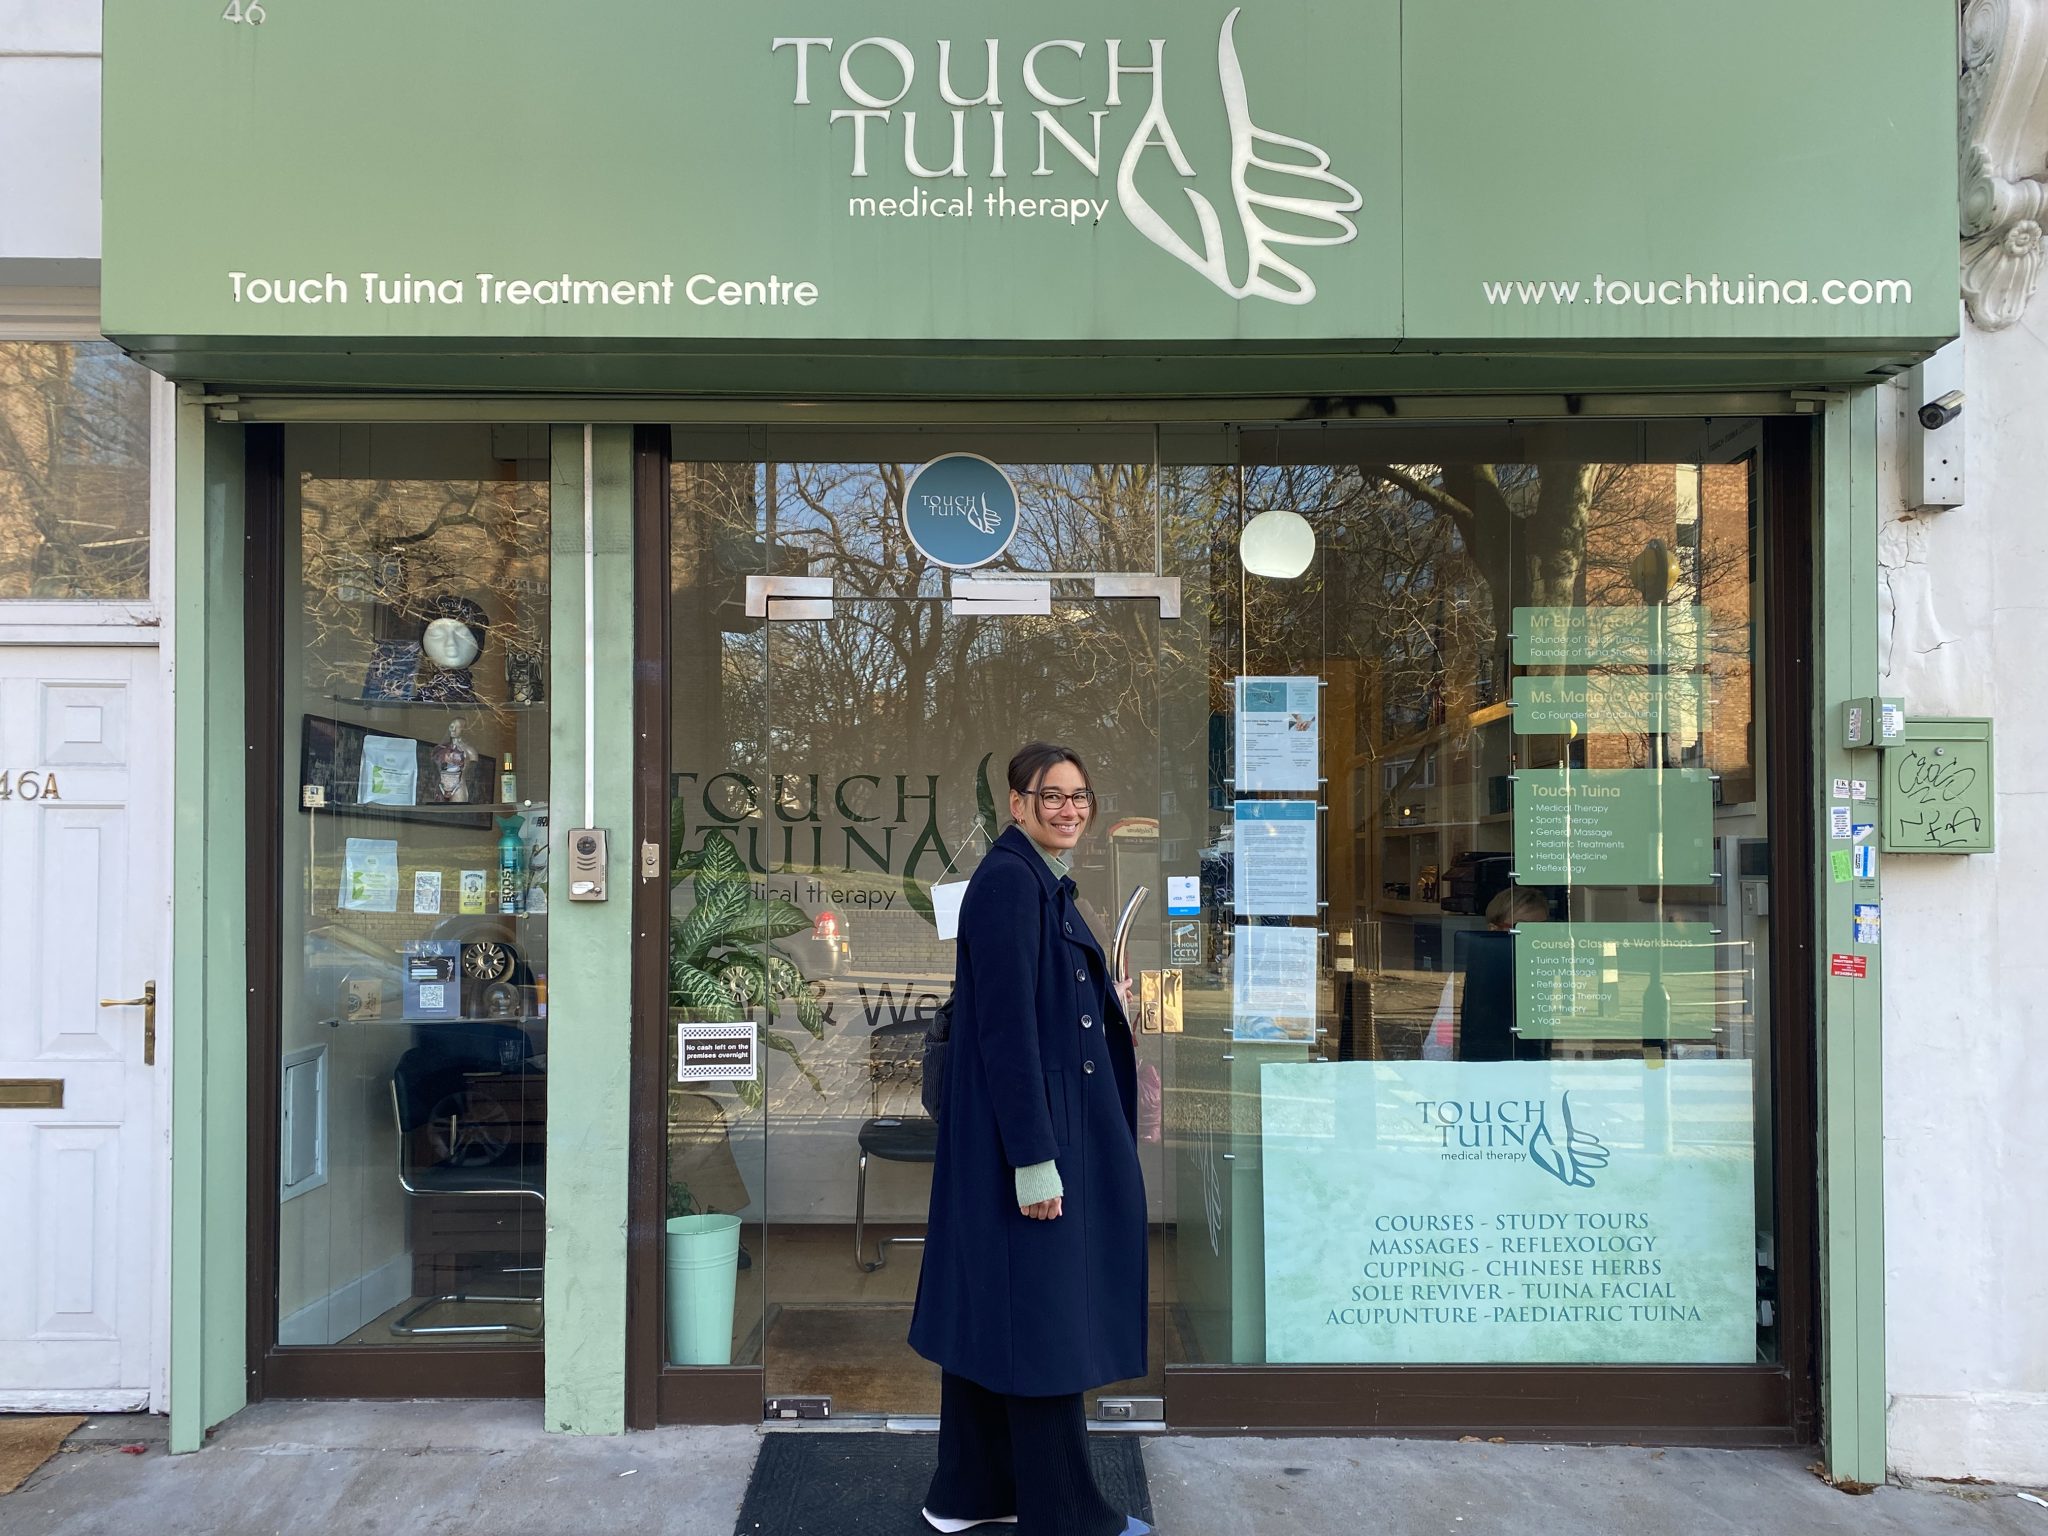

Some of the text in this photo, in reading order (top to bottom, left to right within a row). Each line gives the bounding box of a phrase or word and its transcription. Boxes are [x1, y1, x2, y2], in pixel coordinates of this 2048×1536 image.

[222, 0, 266, 25] 46
[772, 37, 1167, 107] TOUCH
[829, 108, 1197, 178] TUINA
[849, 186, 1109, 226] medical therapy
[228, 270, 819, 307] Touch Tuina Treatment Centre
[1482, 273, 1912, 305] www.touchtuina.com
[921, 495, 975, 507] TOUCH
[928, 505, 979, 517] TUINA
[1530, 615, 1548, 628] Mr
[1530, 635, 1568, 645] Founder
[1571, 635, 1581, 644] of
[1530, 648, 1569, 657] Founder
[1571, 648, 1581, 657] of
[1531, 690, 1556, 704] Ms.
[1532, 711, 1546, 720] Co
[0, 770, 61, 801] 46A
[1532, 784, 1621, 798] Touch Tuina
[1536, 804, 1608, 814] Medical Therapy
[1536, 816, 1562, 825] Sports
[1574, 828, 1613, 838] Massage
[1577, 840, 1625, 849] Treatments
[1536, 852, 1565, 860] Herbal
[806, 881, 896, 909] therapy
[1531, 939, 1575, 950] Courses
[1633, 938, 1693, 950] Workshops
[1536, 956, 1559, 965] Tuina
[1536, 969, 1557, 977] Foot
[1537, 992, 1612, 1003] Cupping Therapy
[1537, 1017, 1561, 1026] Yoga
[1415, 1100, 1546, 1124] TOUCH
[1435, 1124, 1555, 1147] TUINA
[1441, 1150, 1527, 1162] medical therapy
[1375, 1214, 1474, 1232] COURSES
[1495, 1213, 1568, 1231] STUDY
[1574, 1212, 1649, 1230] TOURS
[1369, 1237, 1480, 1256] MASSAGES
[1501, 1236, 1657, 1254] REFLEXOLOGY
[1363, 1260, 1465, 1279] CUPPING
[1486, 1259, 1584, 1277] CHINESE
[1591, 1258, 1662, 1276] HERBS
[1351, 1284, 1404, 1302] SOLE
[1411, 1283, 1502, 1301] REVIVER
[1521, 1282, 1594, 1300] TUINA
[1600, 1281, 1676, 1299] FACIAL
[1326, 1306, 1478, 1325] ACUPUNTURE
[1628, 1304, 1702, 1322] TUINA
